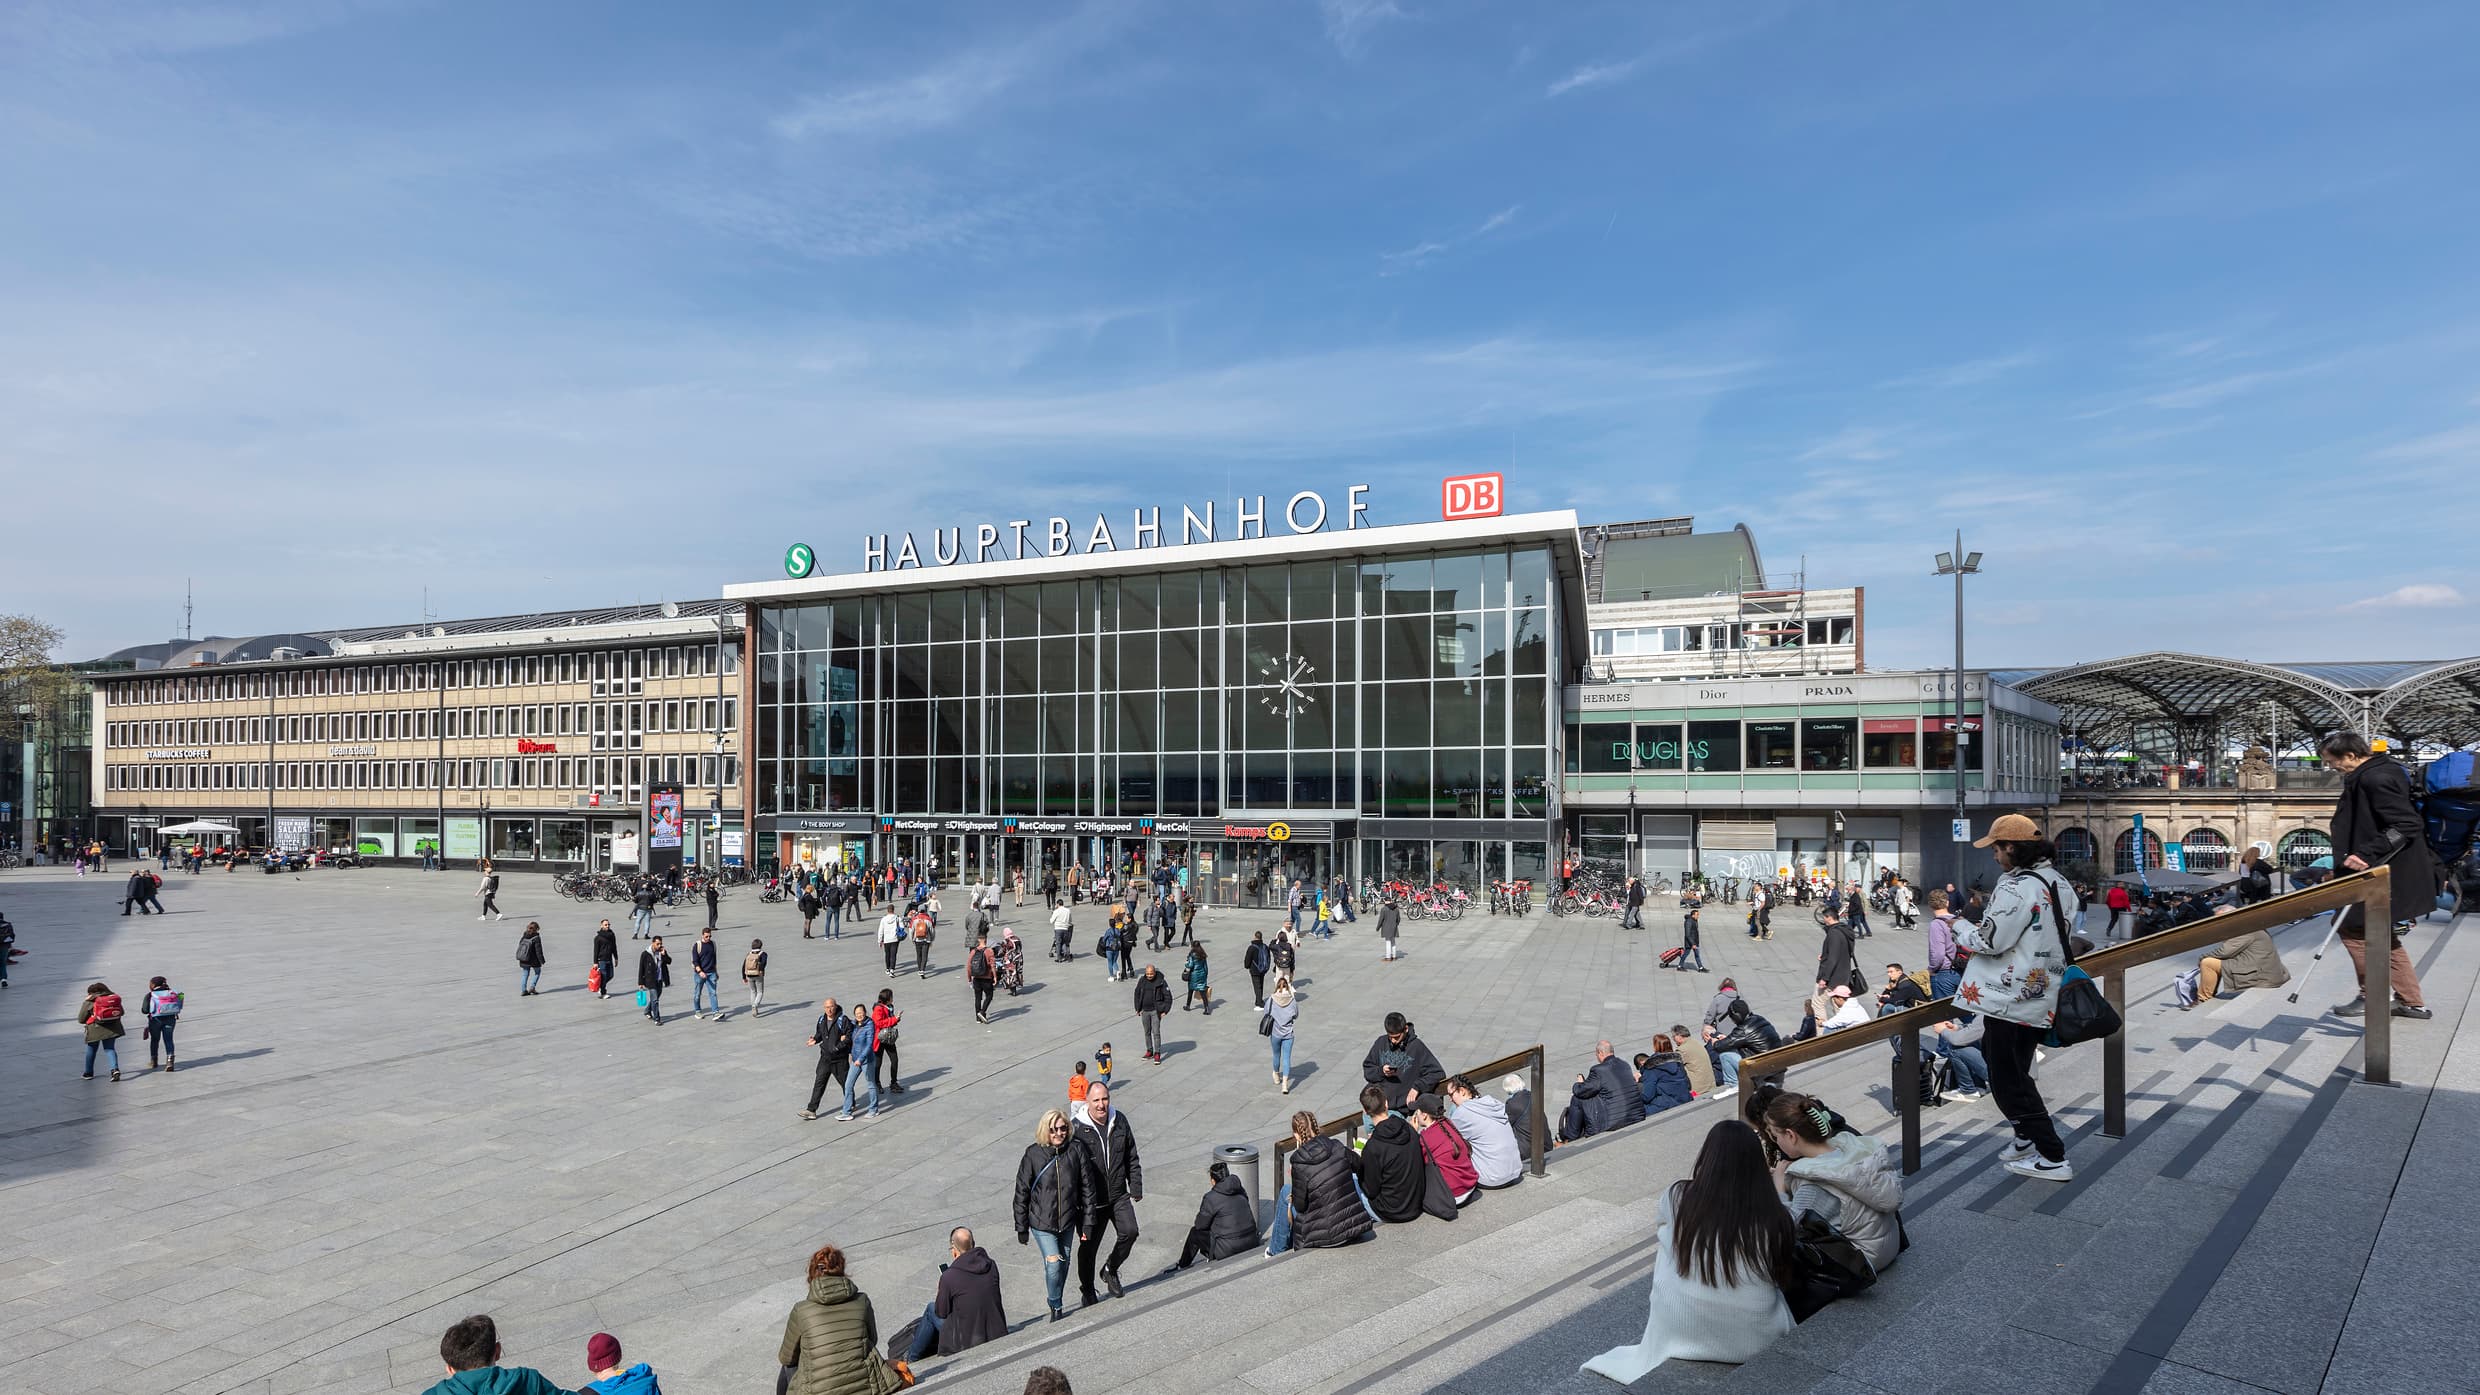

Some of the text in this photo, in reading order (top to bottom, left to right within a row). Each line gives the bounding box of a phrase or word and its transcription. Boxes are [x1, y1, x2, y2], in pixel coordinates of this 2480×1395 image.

[1449, 480, 1495, 513] DB
[864, 484, 1369, 573] HAUPTBAHNHOF
[787, 547, 808, 575] S
[1805, 686, 1853, 696] PRADA
[1923, 681, 1982, 692] GUCCI
[1700, 689, 1728, 700] Dior
[145, 749, 210, 760] STARBUCKS COFFEE
[1612, 740, 1709, 760] DOUGLAS
[895, 821, 939, 831] NetCologne
[957, 821, 998, 832] Highspeed
[1018, 822, 1066, 833] NetCologne
[1088, 822, 1132, 833] Highspeed
[1225, 825, 1267, 840] Kamps
[2182, 845, 2241, 854] WARTESAAL
